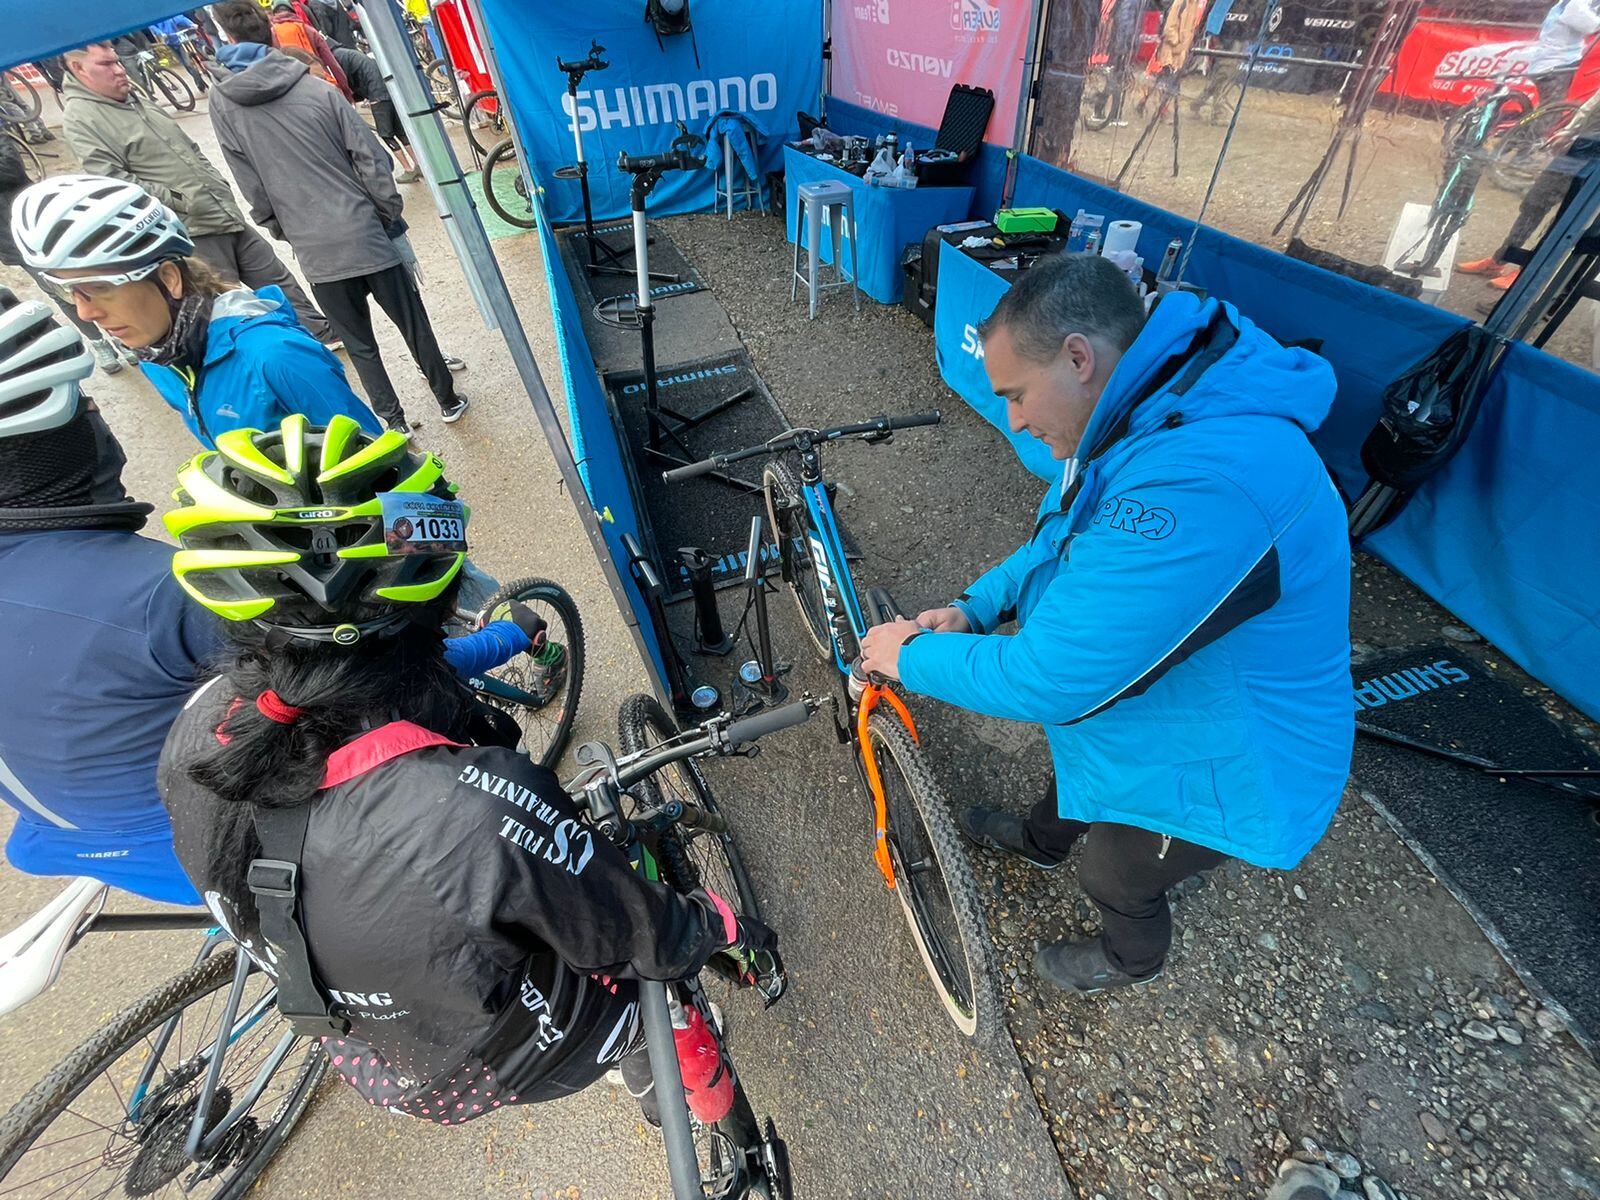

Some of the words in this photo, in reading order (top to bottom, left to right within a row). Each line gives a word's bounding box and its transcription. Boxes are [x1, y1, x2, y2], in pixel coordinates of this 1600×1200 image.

[1304, 17, 1355, 29] venzo
[561, 73, 777, 132] SHIMANO
[143, 209, 160, 225] GIRO
[299, 511, 334, 519] GIRO
[1093, 497, 1176, 540] PRO
[415, 519, 459, 540] 1033
[458, 765, 560, 826] TRAINING
[499, 815, 545, 855] FULL
[543, 818, 594, 875] CS
[328, 989, 393, 1006] ING
[359, 1009, 411, 1020] Plata
